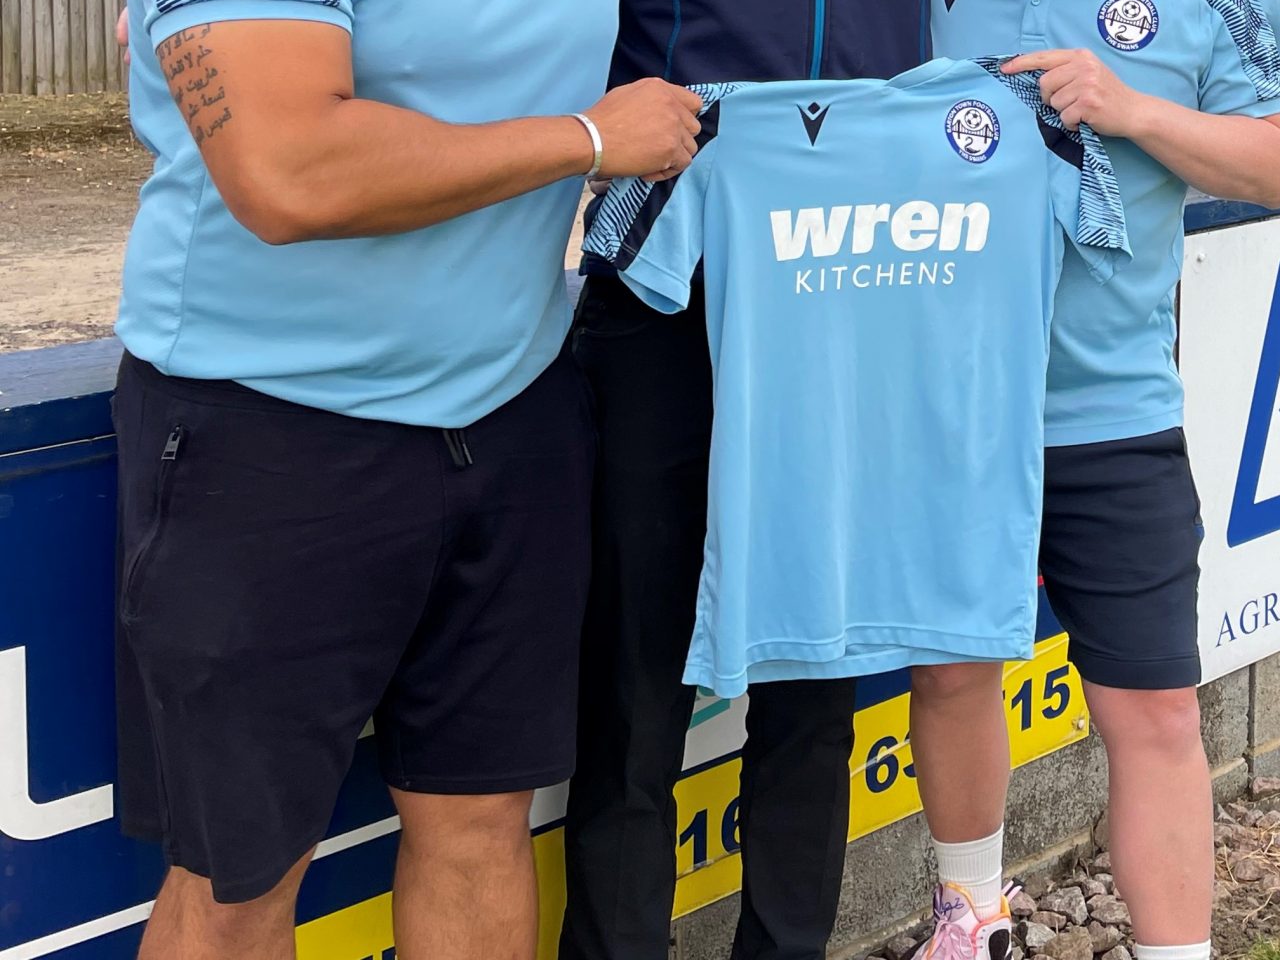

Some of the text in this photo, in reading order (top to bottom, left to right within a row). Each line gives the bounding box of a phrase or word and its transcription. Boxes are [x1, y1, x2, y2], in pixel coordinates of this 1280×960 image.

[769, 200, 990, 261] wren
[795, 261, 956, 294] KITCHENS
[1003, 665, 1070, 732] 15
